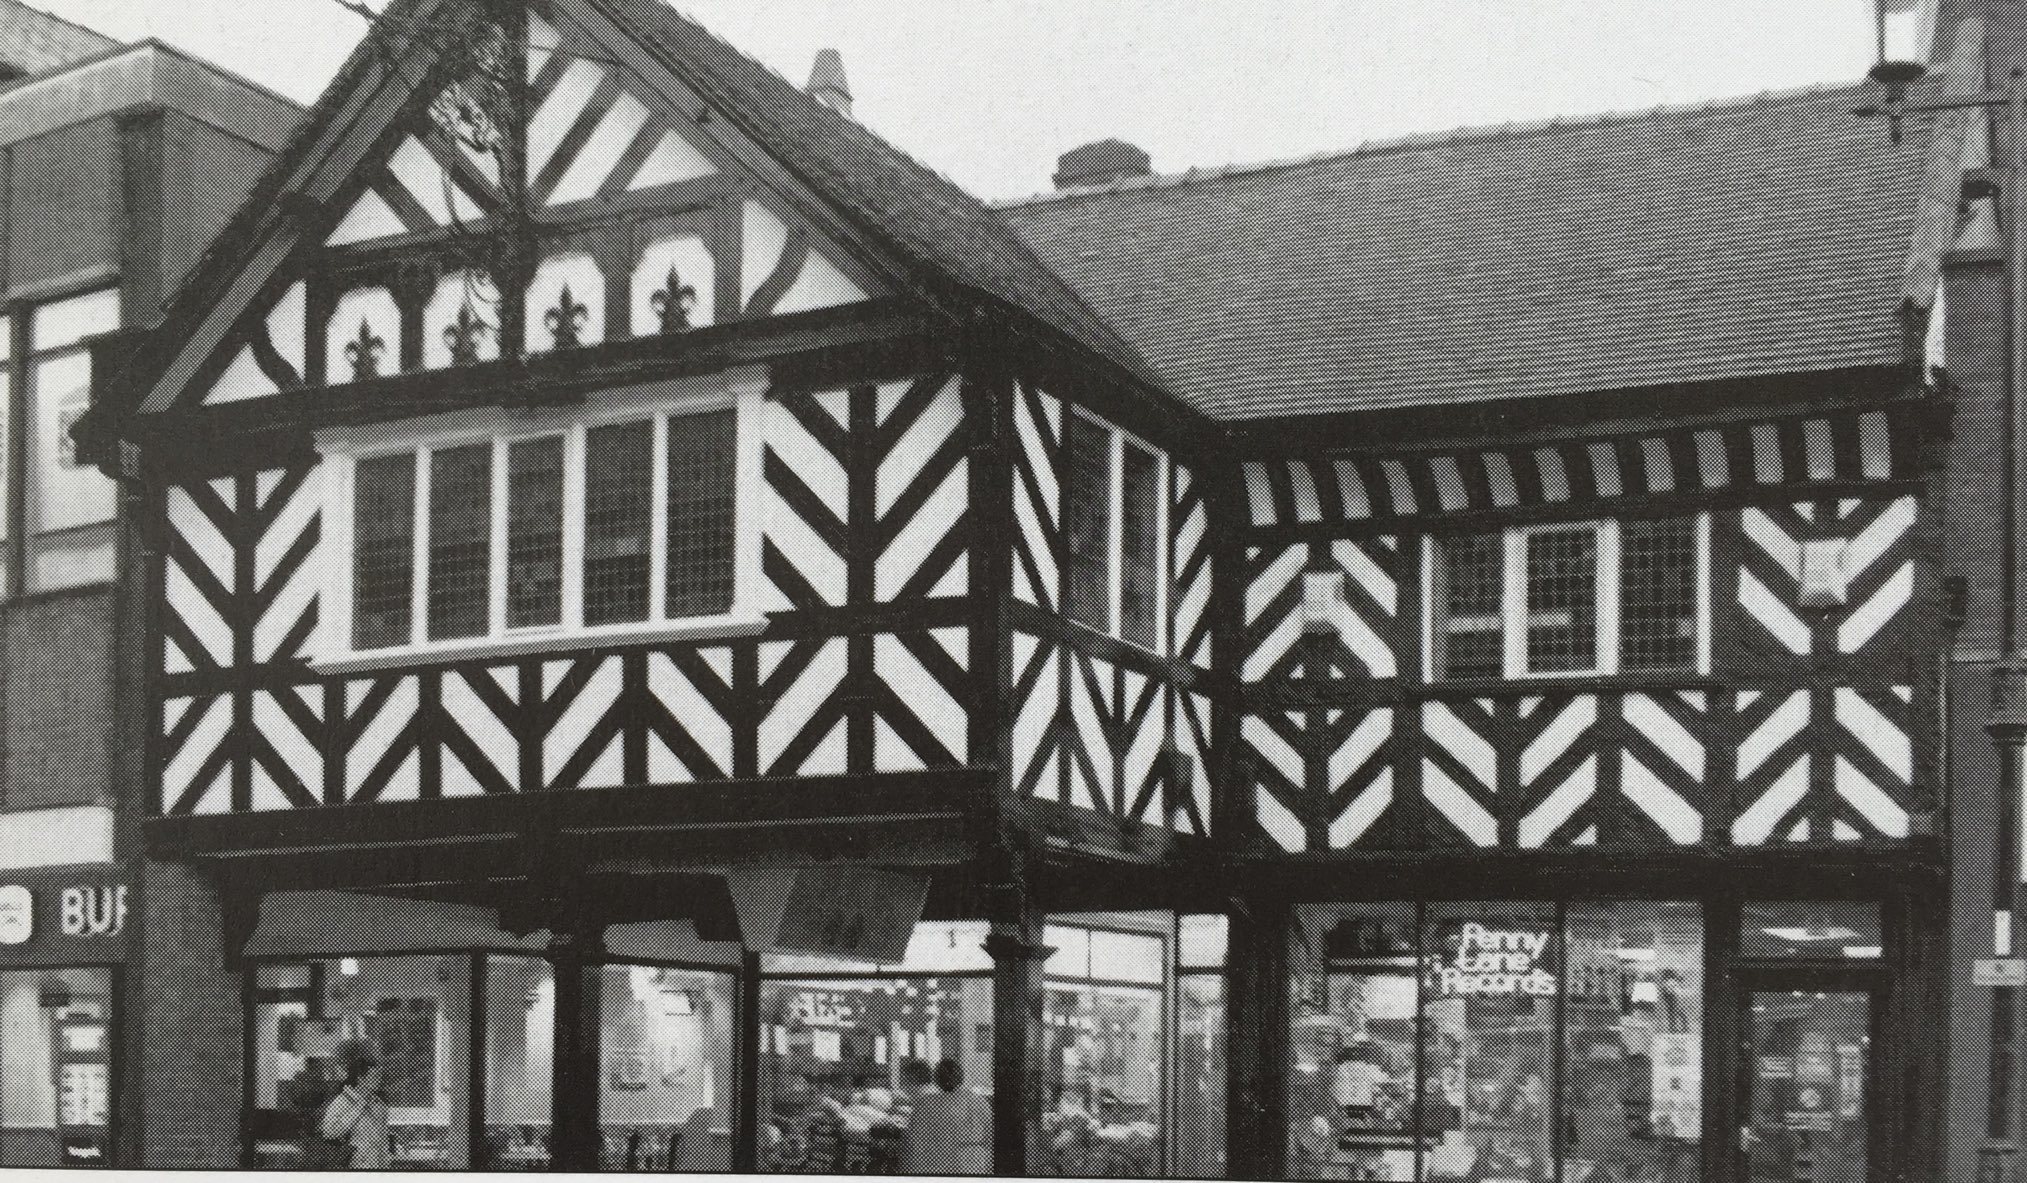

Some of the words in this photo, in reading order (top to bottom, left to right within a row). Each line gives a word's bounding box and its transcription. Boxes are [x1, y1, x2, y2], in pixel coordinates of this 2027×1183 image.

[1460, 922, 1549, 959] Penny
[1455, 945, 1531, 973] Lane
[1440, 967, 1557, 995] Records
